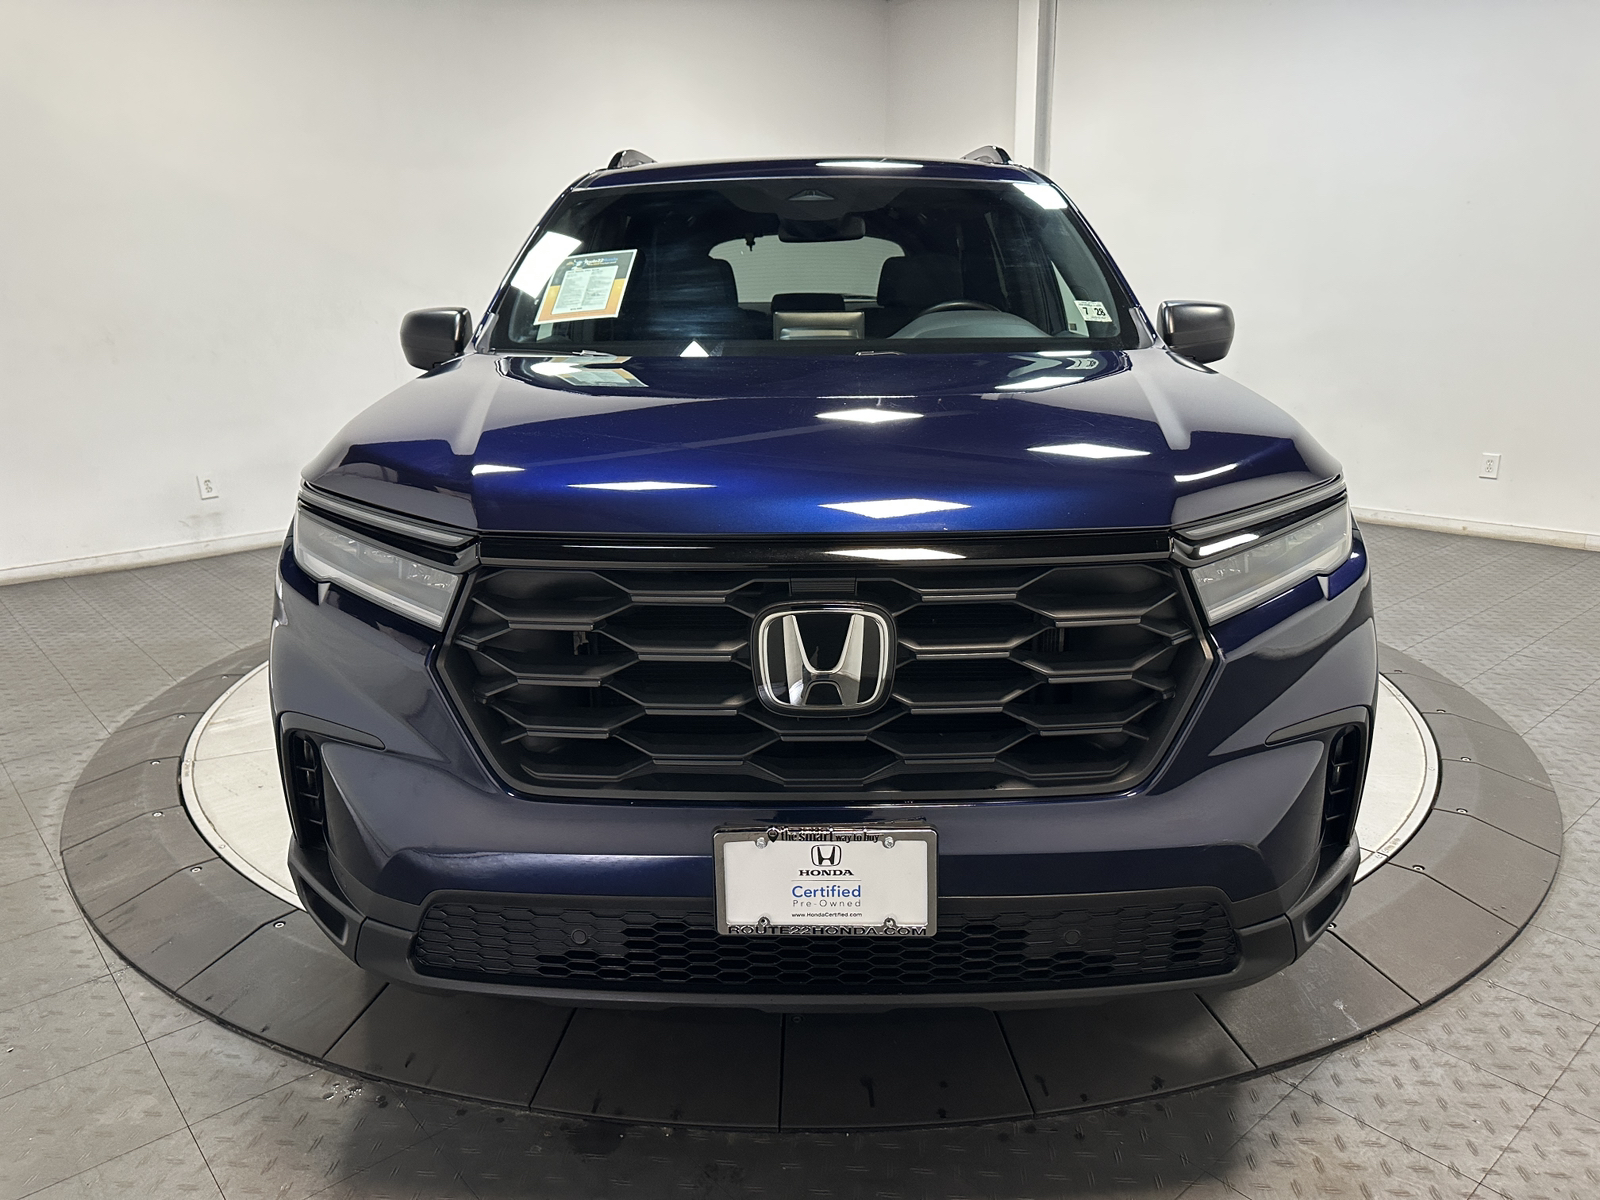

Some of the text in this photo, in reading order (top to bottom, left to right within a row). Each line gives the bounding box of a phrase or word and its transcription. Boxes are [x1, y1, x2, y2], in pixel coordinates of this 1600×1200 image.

[1082, 307, 1106, 316] 7 28
[780, 829, 798, 842] the
[835, 834, 852, 844] way
[853, 832, 862, 842] to
[863, 829, 880, 844] buy
[799, 869, 854, 877] HONDA
[792, 885, 861, 898] Certified
[792, 899, 861, 908] Pre-Owned
[728, 925, 928, 936] ROUTE22HONDA.COM
